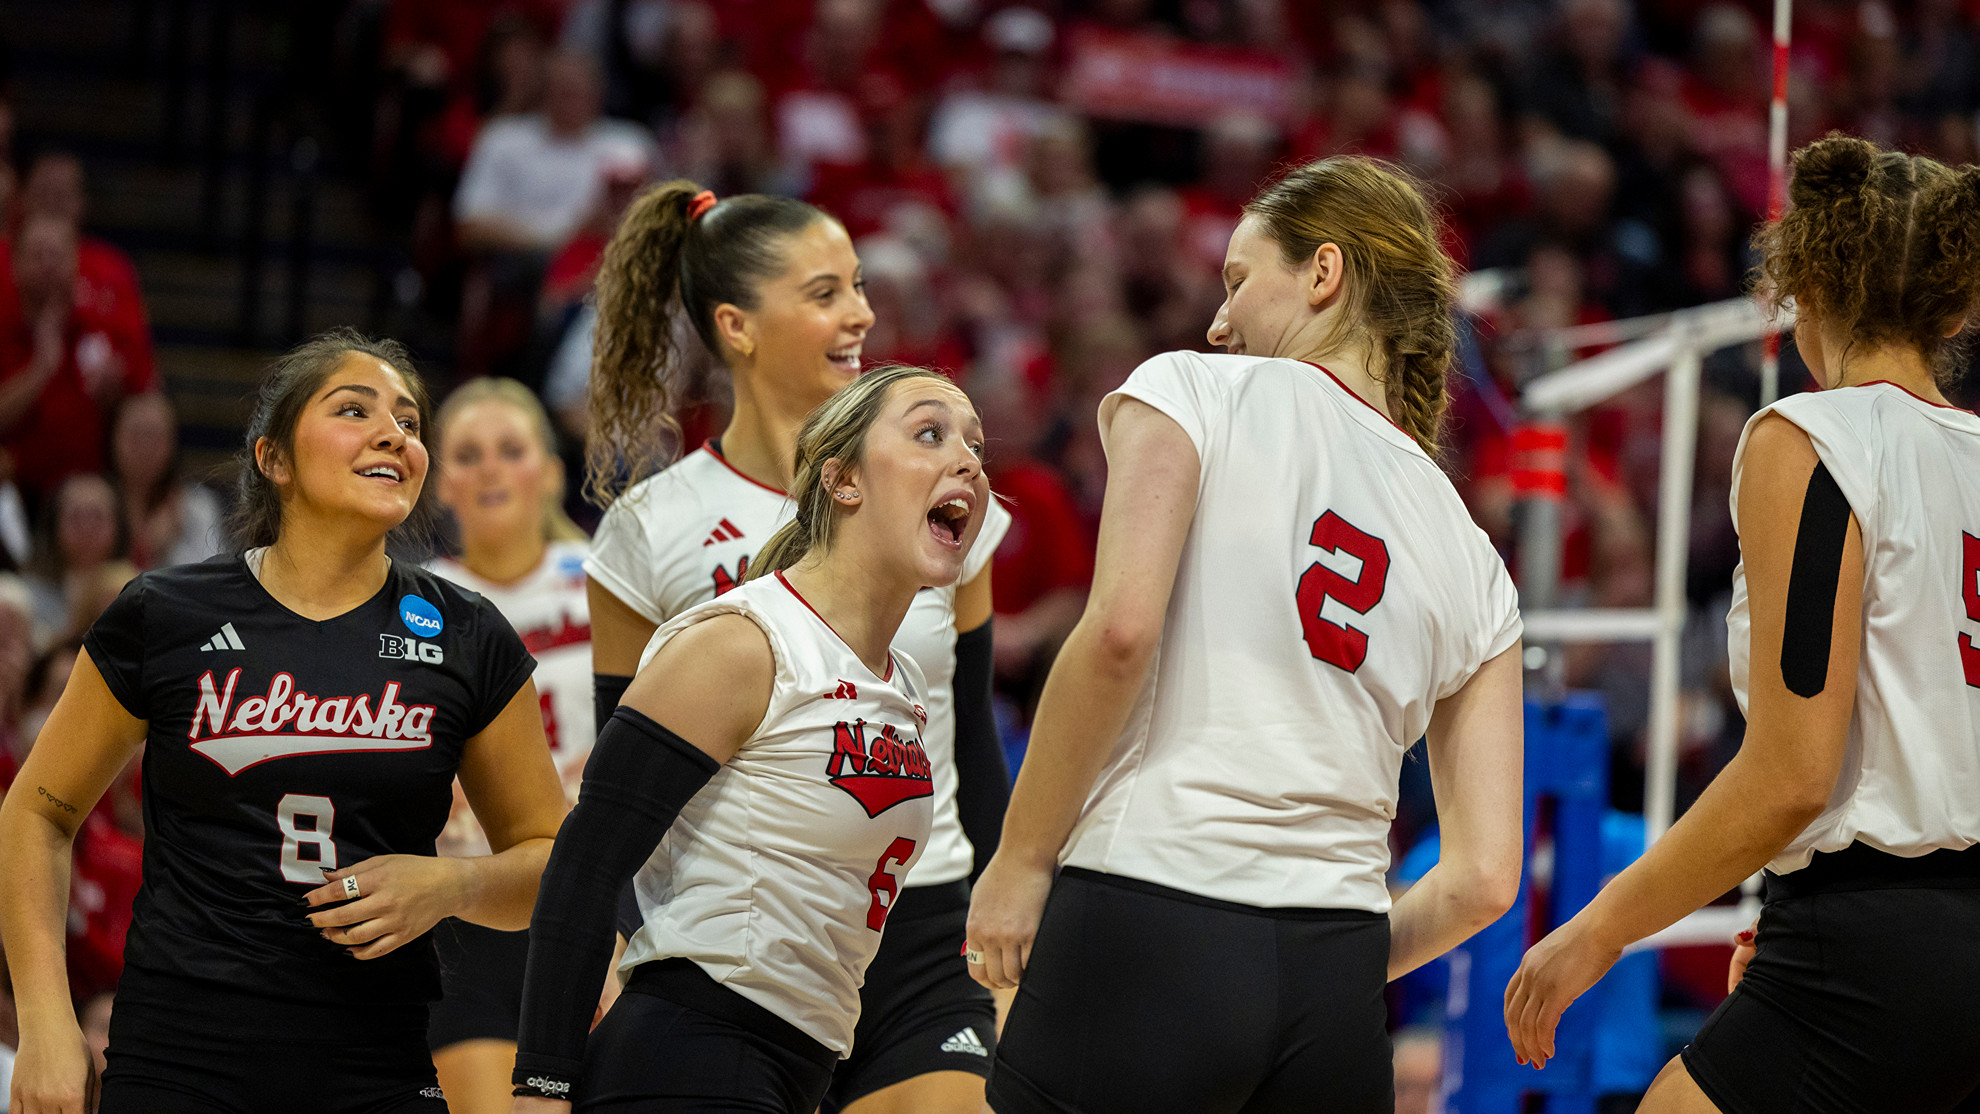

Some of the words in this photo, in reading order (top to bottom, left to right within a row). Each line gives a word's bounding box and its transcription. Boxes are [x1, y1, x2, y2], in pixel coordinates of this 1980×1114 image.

[405, 611, 441, 630] NCAA
[1295, 508, 1391, 675] 2
[187, 667, 437, 744] Nebraska
[277, 793, 337, 885] 8
[866, 836, 916, 932] 6
